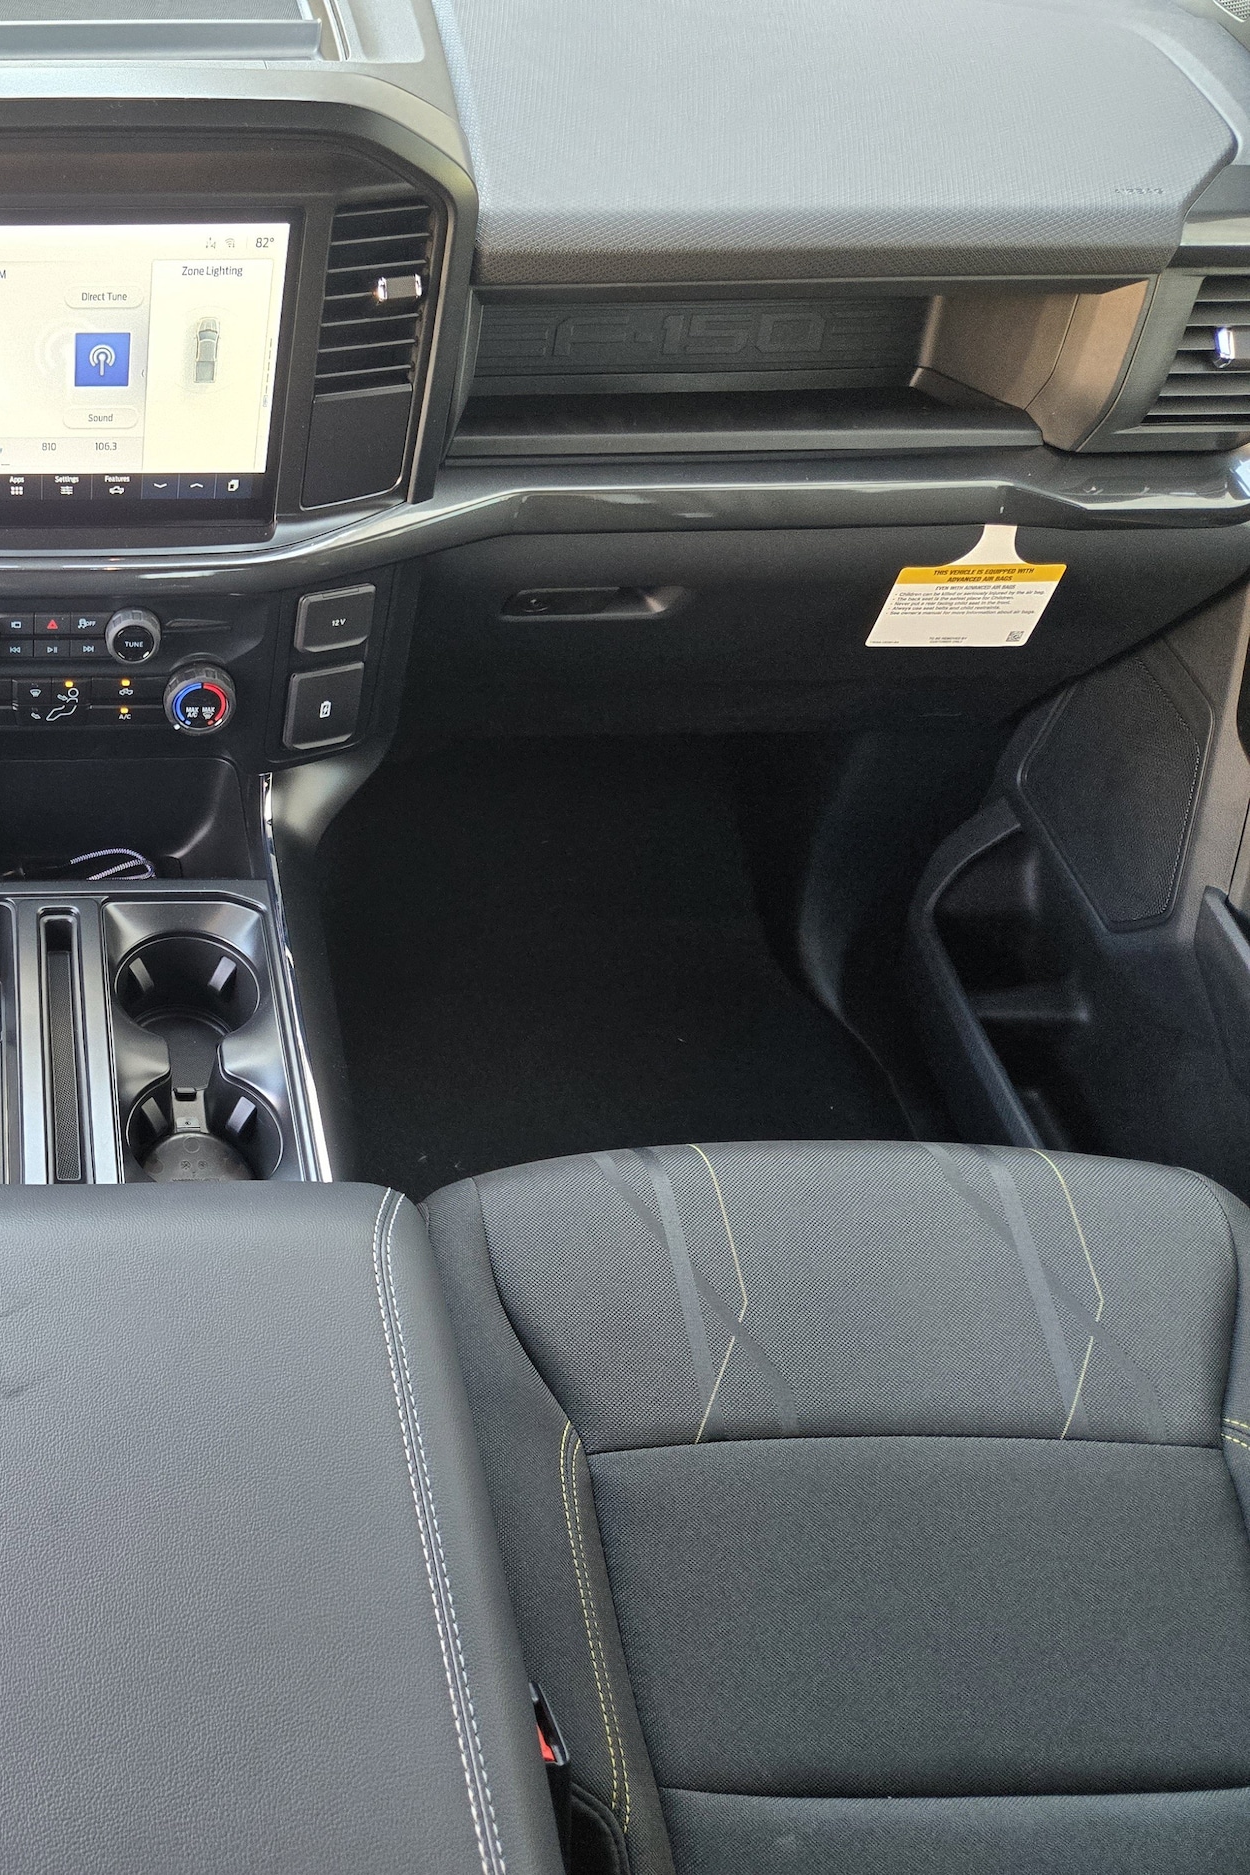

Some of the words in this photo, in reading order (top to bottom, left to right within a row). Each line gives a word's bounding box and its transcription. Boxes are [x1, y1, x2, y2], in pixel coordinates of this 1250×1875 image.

[182, 266, 205, 276] Zone
[206, 266, 243, 277] Lighting
[82, 292, 105, 301] Direct
[106, 292, 128, 301] Tune
[553, 312, 825, 357] F-150
[88, 414, 113, 423] Sound
[42, 442, 56, 451] 810
[95, 442, 117, 451] 106.3
[9, 476, 25, 484] Apps
[54, 476, 80, 484] Settings
[105, 475, 130, 483] Features
